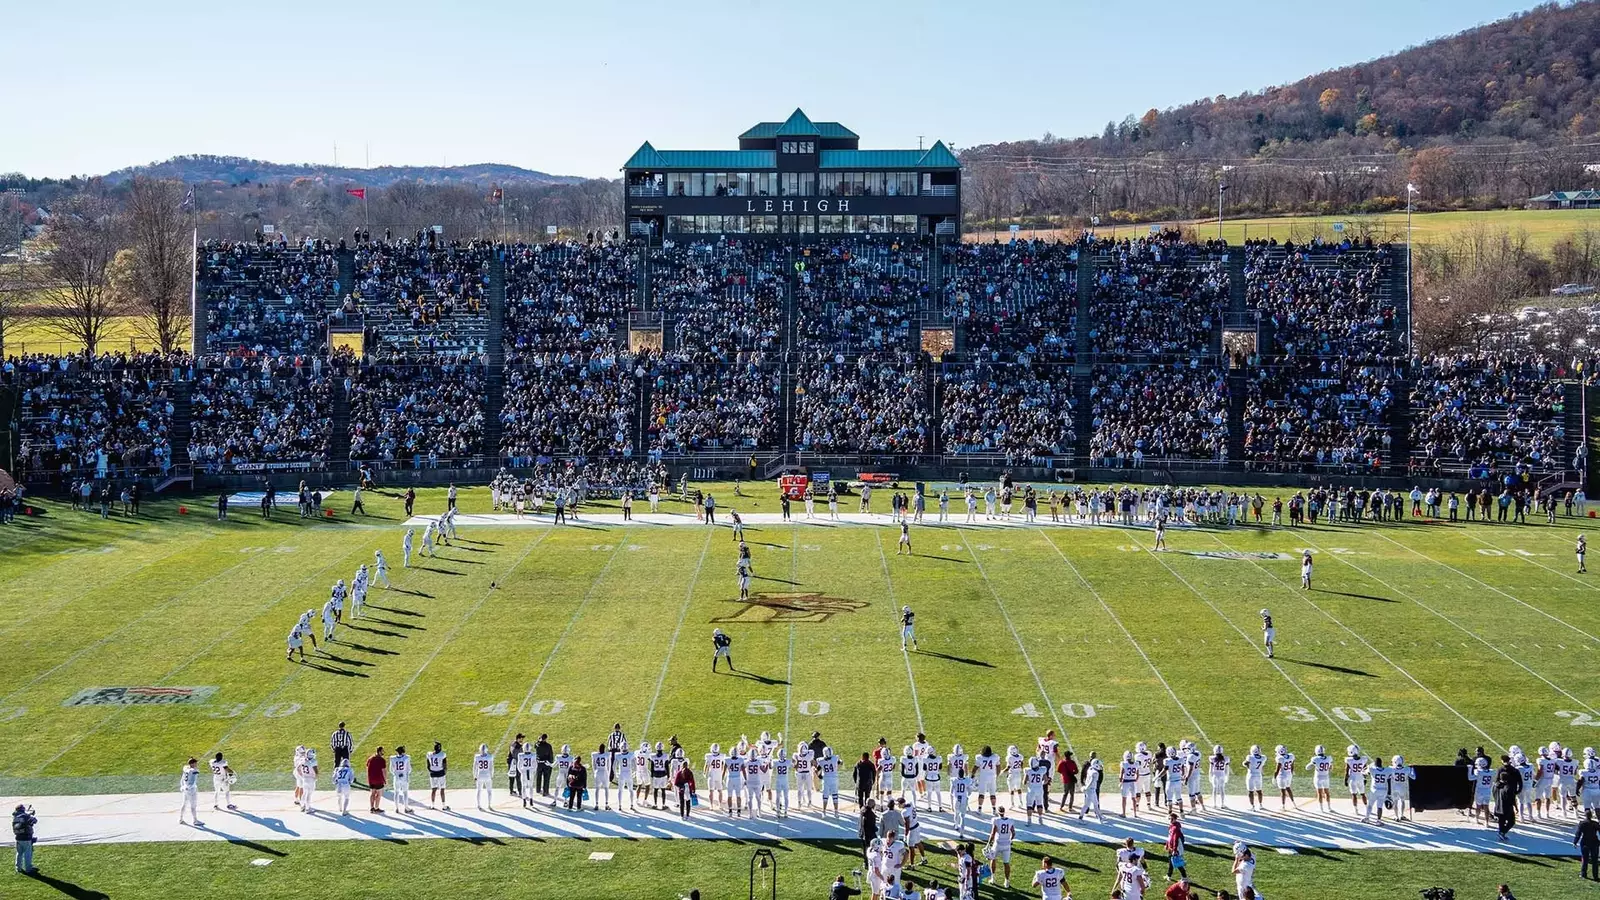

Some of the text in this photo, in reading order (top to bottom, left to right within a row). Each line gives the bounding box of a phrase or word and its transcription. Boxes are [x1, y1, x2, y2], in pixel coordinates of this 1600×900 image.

[747, 200, 850, 212] LEHIGH
[477, 700, 567, 716] 40
[745, 700, 831, 716] 50
[1009, 702, 1100, 719] 40
[1278, 705, 1373, 723] 30
[395, 761, 404, 770] 12
[430, 757, 439, 767] 14
[478, 760, 489, 769] 38
[523, 758, 532, 767] 31
[596, 757, 606, 767] 43
[622, 758, 628, 767] 9
[654, 759, 664, 768] 24
[711, 759, 721, 769] 46
[907, 762, 913, 771] 3
[928, 762, 939, 771] 83
[953, 759, 964, 769] 49
[982, 760, 993, 770] 74
[1215, 761, 1225, 771] 42
[1256, 761, 1262, 770] 7
[1319, 762, 1330, 772] 90
[729, 763, 739, 772] 45
[748, 764, 759, 774] 56
[777, 765, 787, 775] 82
[823, 763, 834, 773] 64
[884, 763, 893, 772] 23
[1126, 767, 1136, 777] 39
[1172, 763, 1182, 773] 65
[1352, 763, 1363, 773] 95
[1562, 765, 1573, 775] 54
[337, 769, 348, 779] 37
[1031, 773, 1041, 783] 76
[1375, 774, 1385, 783] 55
[1394, 772, 1405, 782] 36
[956, 783, 965, 793] 10
[1000, 824, 1009, 834] 81
[1045, 877, 1057, 888] 62
[1122, 871, 1133, 884] 78
